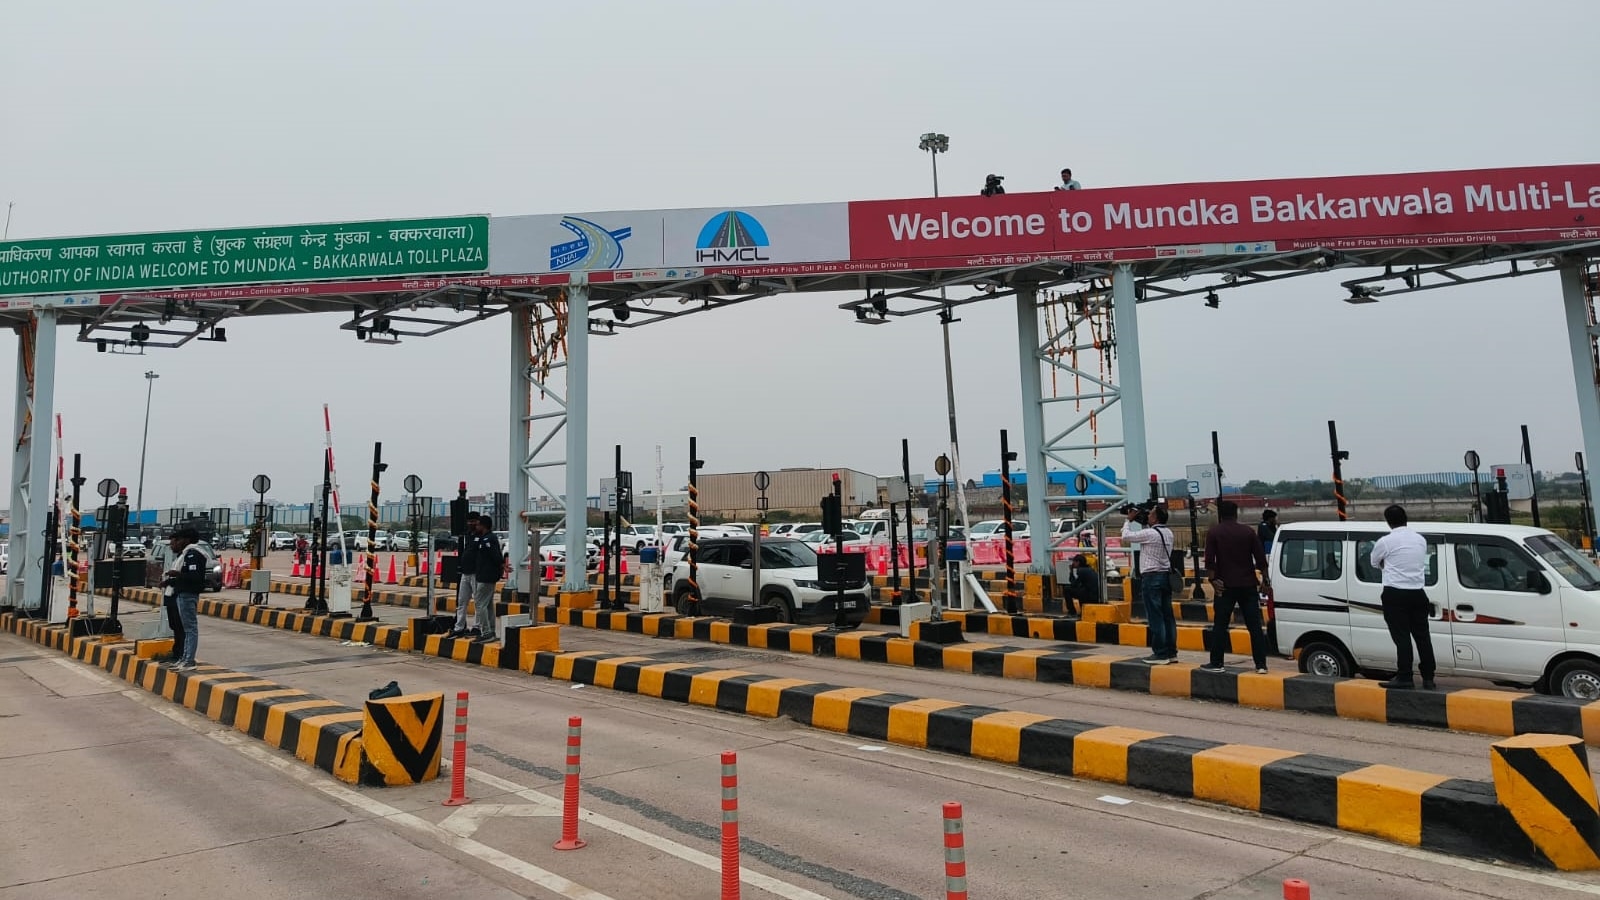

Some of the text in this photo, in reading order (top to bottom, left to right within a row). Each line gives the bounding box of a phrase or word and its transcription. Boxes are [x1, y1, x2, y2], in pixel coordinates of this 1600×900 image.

[888, 210, 1045, 241] Welcome
[1058, 208, 1093, 234] to
[1103, 198, 1239, 231] Mundka
[1250, 187, 1454, 224] Bakkarwala
[58, 245, 99, 260] आपका
[106, 242, 145, 258] स्वागत
[152, 239, 186, 254] करता
[193, 235, 203, 253] है
[211, 235, 246, 257] (शुल्क
[253, 231, 293, 250] संग्रहण
[300, 229, 327, 247] केन्द्र
[334, 227, 370, 251] मुंडका
[388, 223, 474, 244] बक्करवाला)
[1427, 236, 1464, 244] Continue
[1467, 234, 1496, 243] Driving
[556, 252, 577, 266] NHAI
[695, 247, 769, 263] IHMCL
[73, 267, 92, 282] OF
[95, 264, 135, 281] INDIA
[140, 260, 208, 279] WELCOME
[212, 259, 229, 275] TO
[234, 256, 296, 274] MUNDKA
[313, 250, 404, 270] BAKKARWALA
[408, 249, 439, 264] TOLL
[441, 246, 483, 263] PLAZA
[781, 265, 798, 273] Flow
[881, 261, 909, 269] Driving
